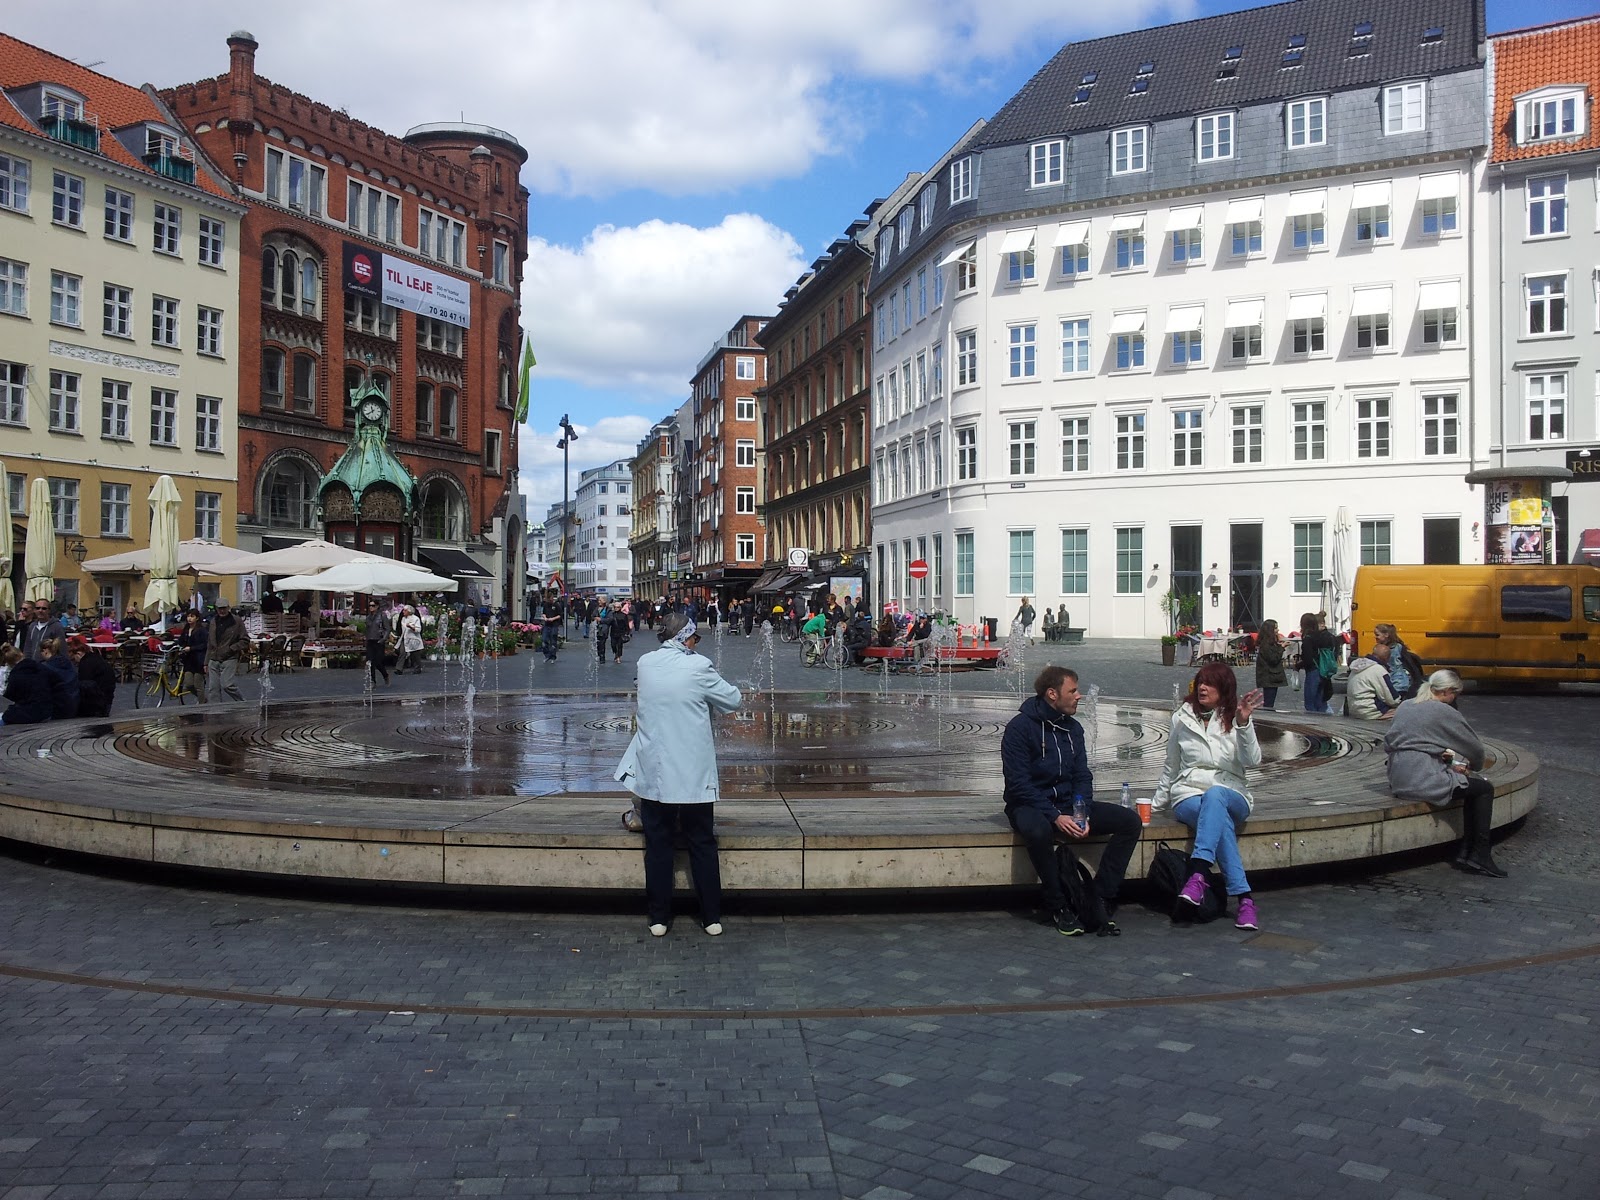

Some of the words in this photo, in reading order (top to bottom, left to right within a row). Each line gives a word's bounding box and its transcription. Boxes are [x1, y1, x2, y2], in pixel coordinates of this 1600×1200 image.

[386, 269, 403, 285] TIL
[406, 275, 433, 294] LEJE
[429, 306, 438, 315] 70
[439, 309, 448, 318] 20
[449, 312, 457, 321] 47
[458, 315, 466, 324] 11
